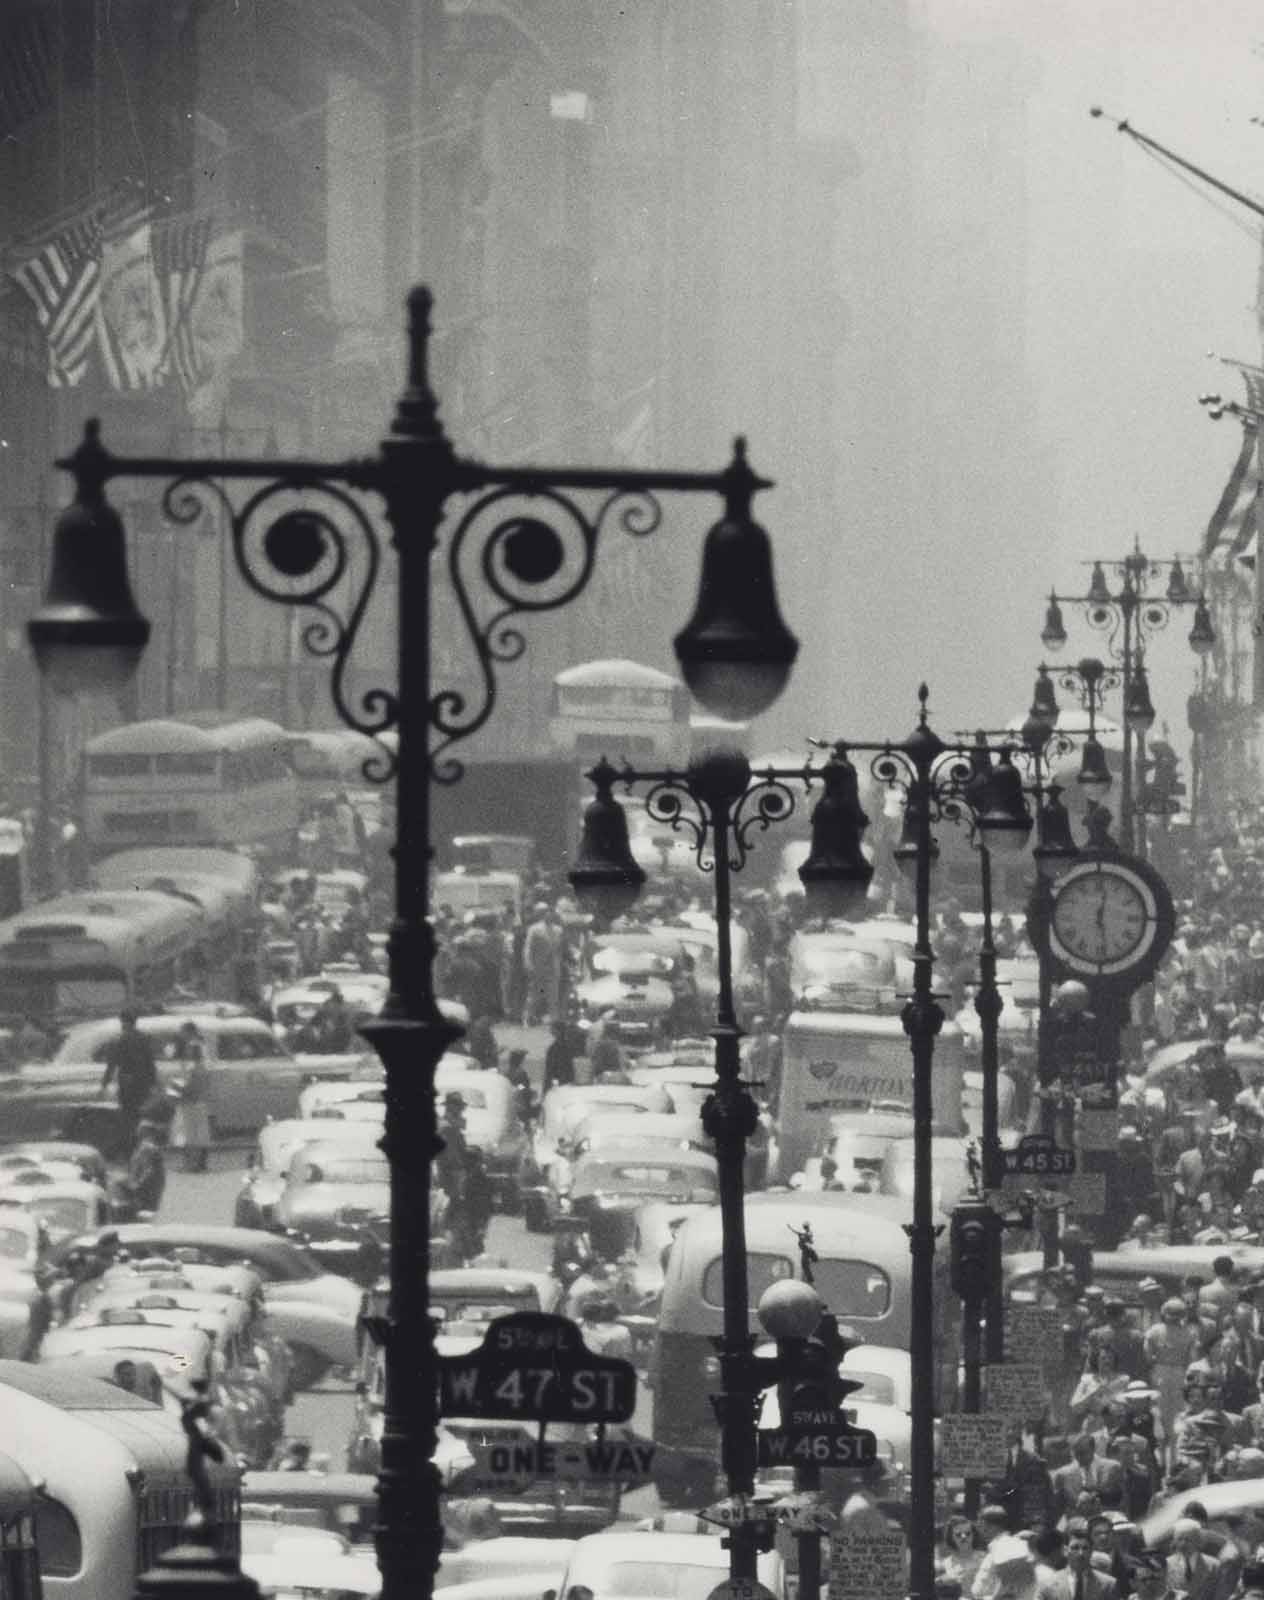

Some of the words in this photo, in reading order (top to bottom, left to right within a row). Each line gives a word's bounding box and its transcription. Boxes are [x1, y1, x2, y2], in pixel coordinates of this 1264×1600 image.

[1022, 1152, 1048, 1171] 45
[495, 1367, 555, 1409] 47
[793, 1434, 830, 1460] 46
[731, 1586, 753, 1598] TO
